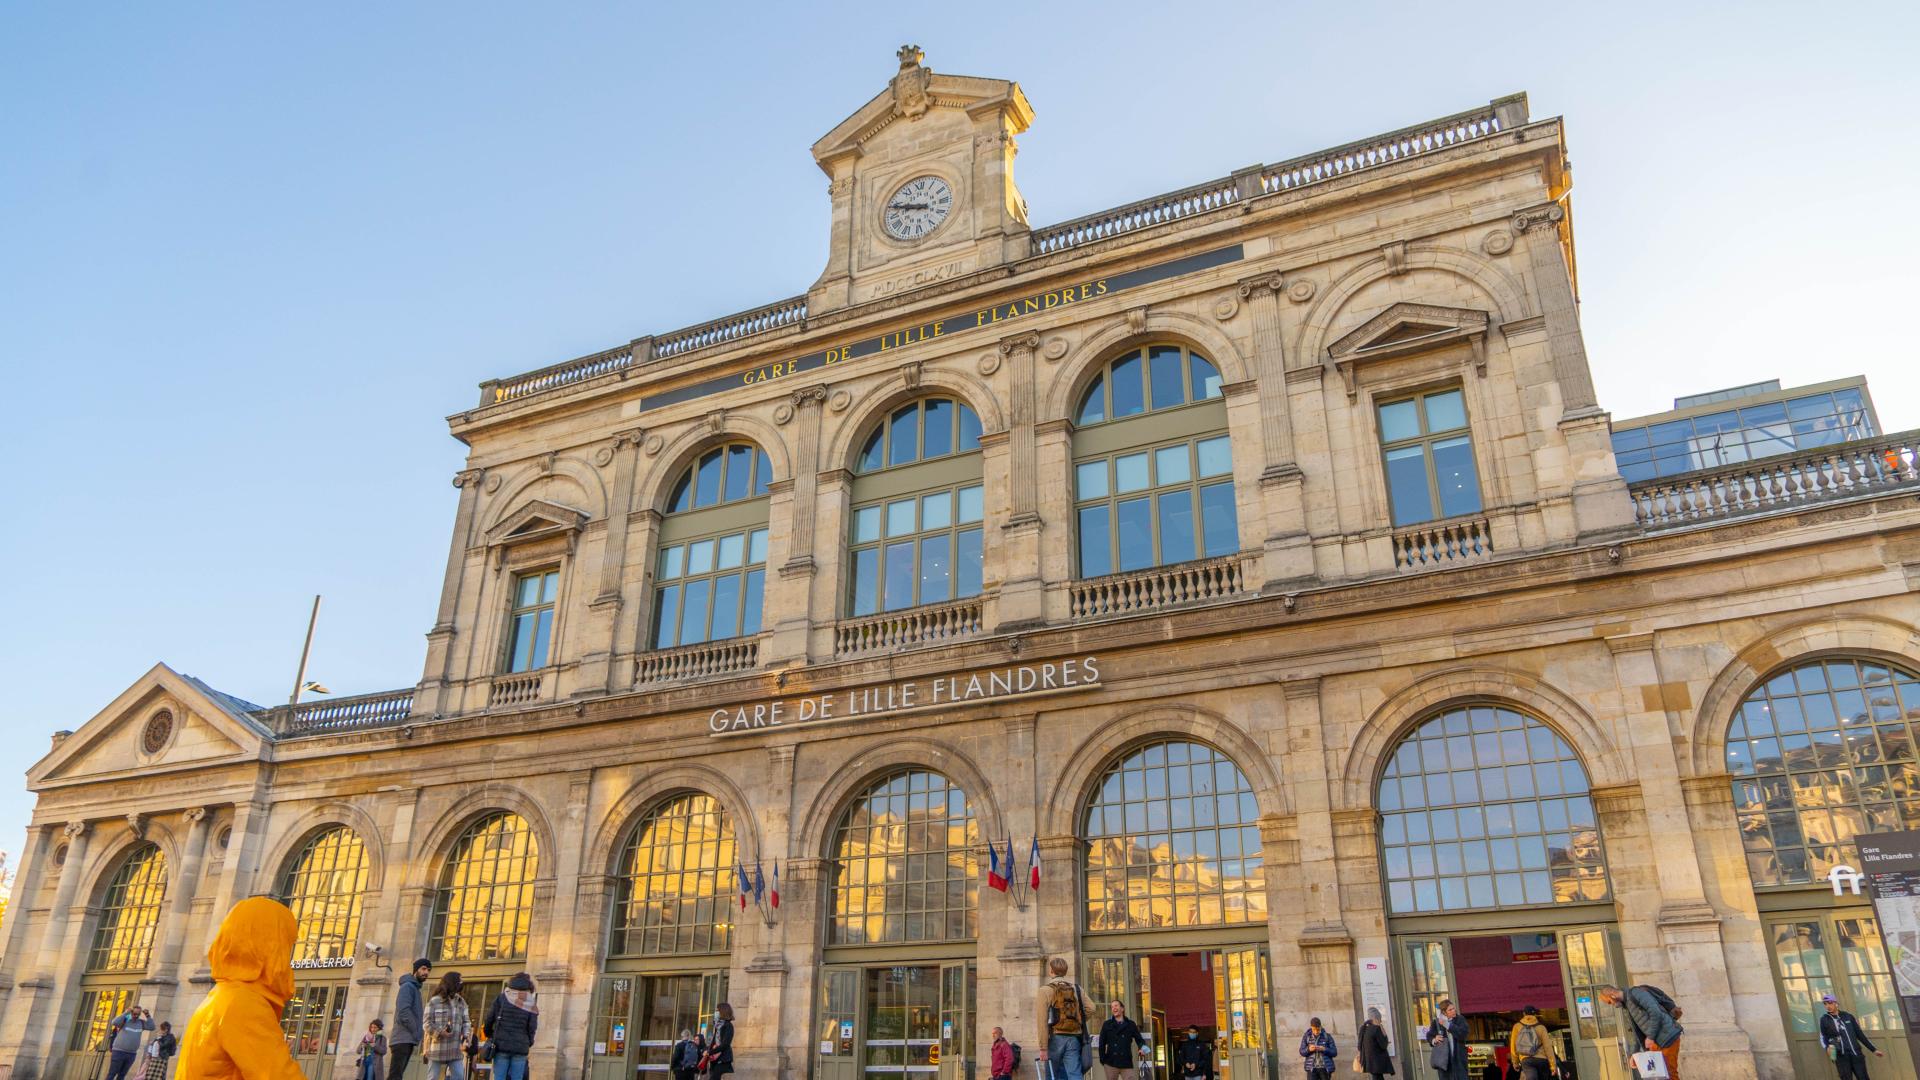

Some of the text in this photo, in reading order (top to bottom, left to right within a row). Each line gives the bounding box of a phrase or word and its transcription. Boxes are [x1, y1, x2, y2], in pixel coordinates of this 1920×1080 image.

[743, 279, 1109, 385] GARE DE LILLE FLANDRES
[711, 656, 1100, 732] GARE DE LILLE FLANDRES
[1881, 852, 1913, 860] Flandres
